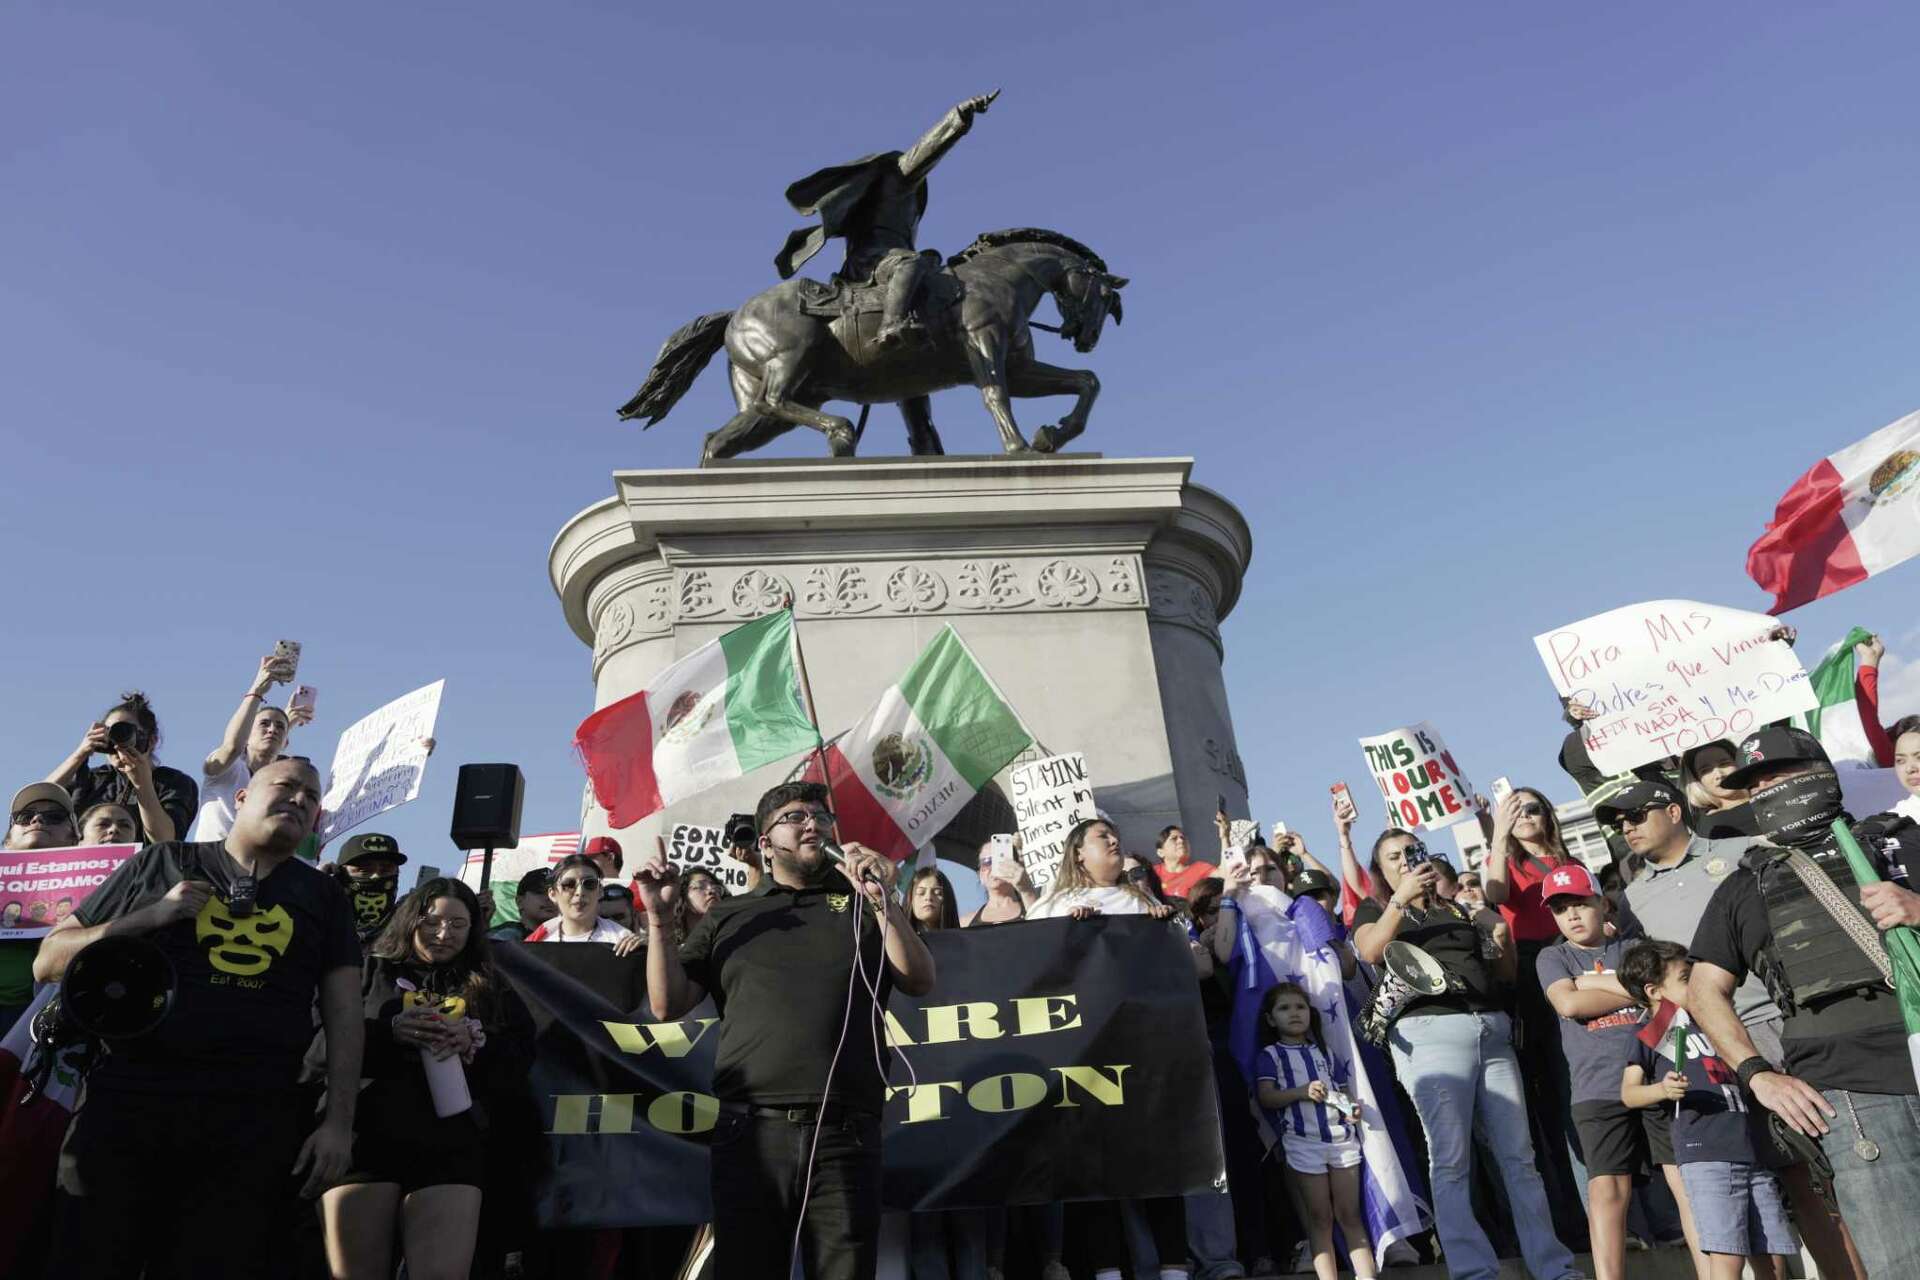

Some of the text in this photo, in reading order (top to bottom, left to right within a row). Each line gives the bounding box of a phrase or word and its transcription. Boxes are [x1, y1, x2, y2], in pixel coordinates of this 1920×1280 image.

[1548, 612, 1712, 689] Para Mis
[1667, 660, 1708, 688] que
[1712, 635, 1770, 666] Vinie
[1634, 706, 1699, 736] NADA
[1649, 708, 1754, 755] TODO
[1364, 731, 1436, 773] THIS IS
[25, 859, 109, 875] Estamos
[668, 841, 724, 867] SUS
[1020, 840, 1065, 867] INJU
[7, 875, 110, 893] QUEDAMO
[598, 1017, 720, 1058] W
